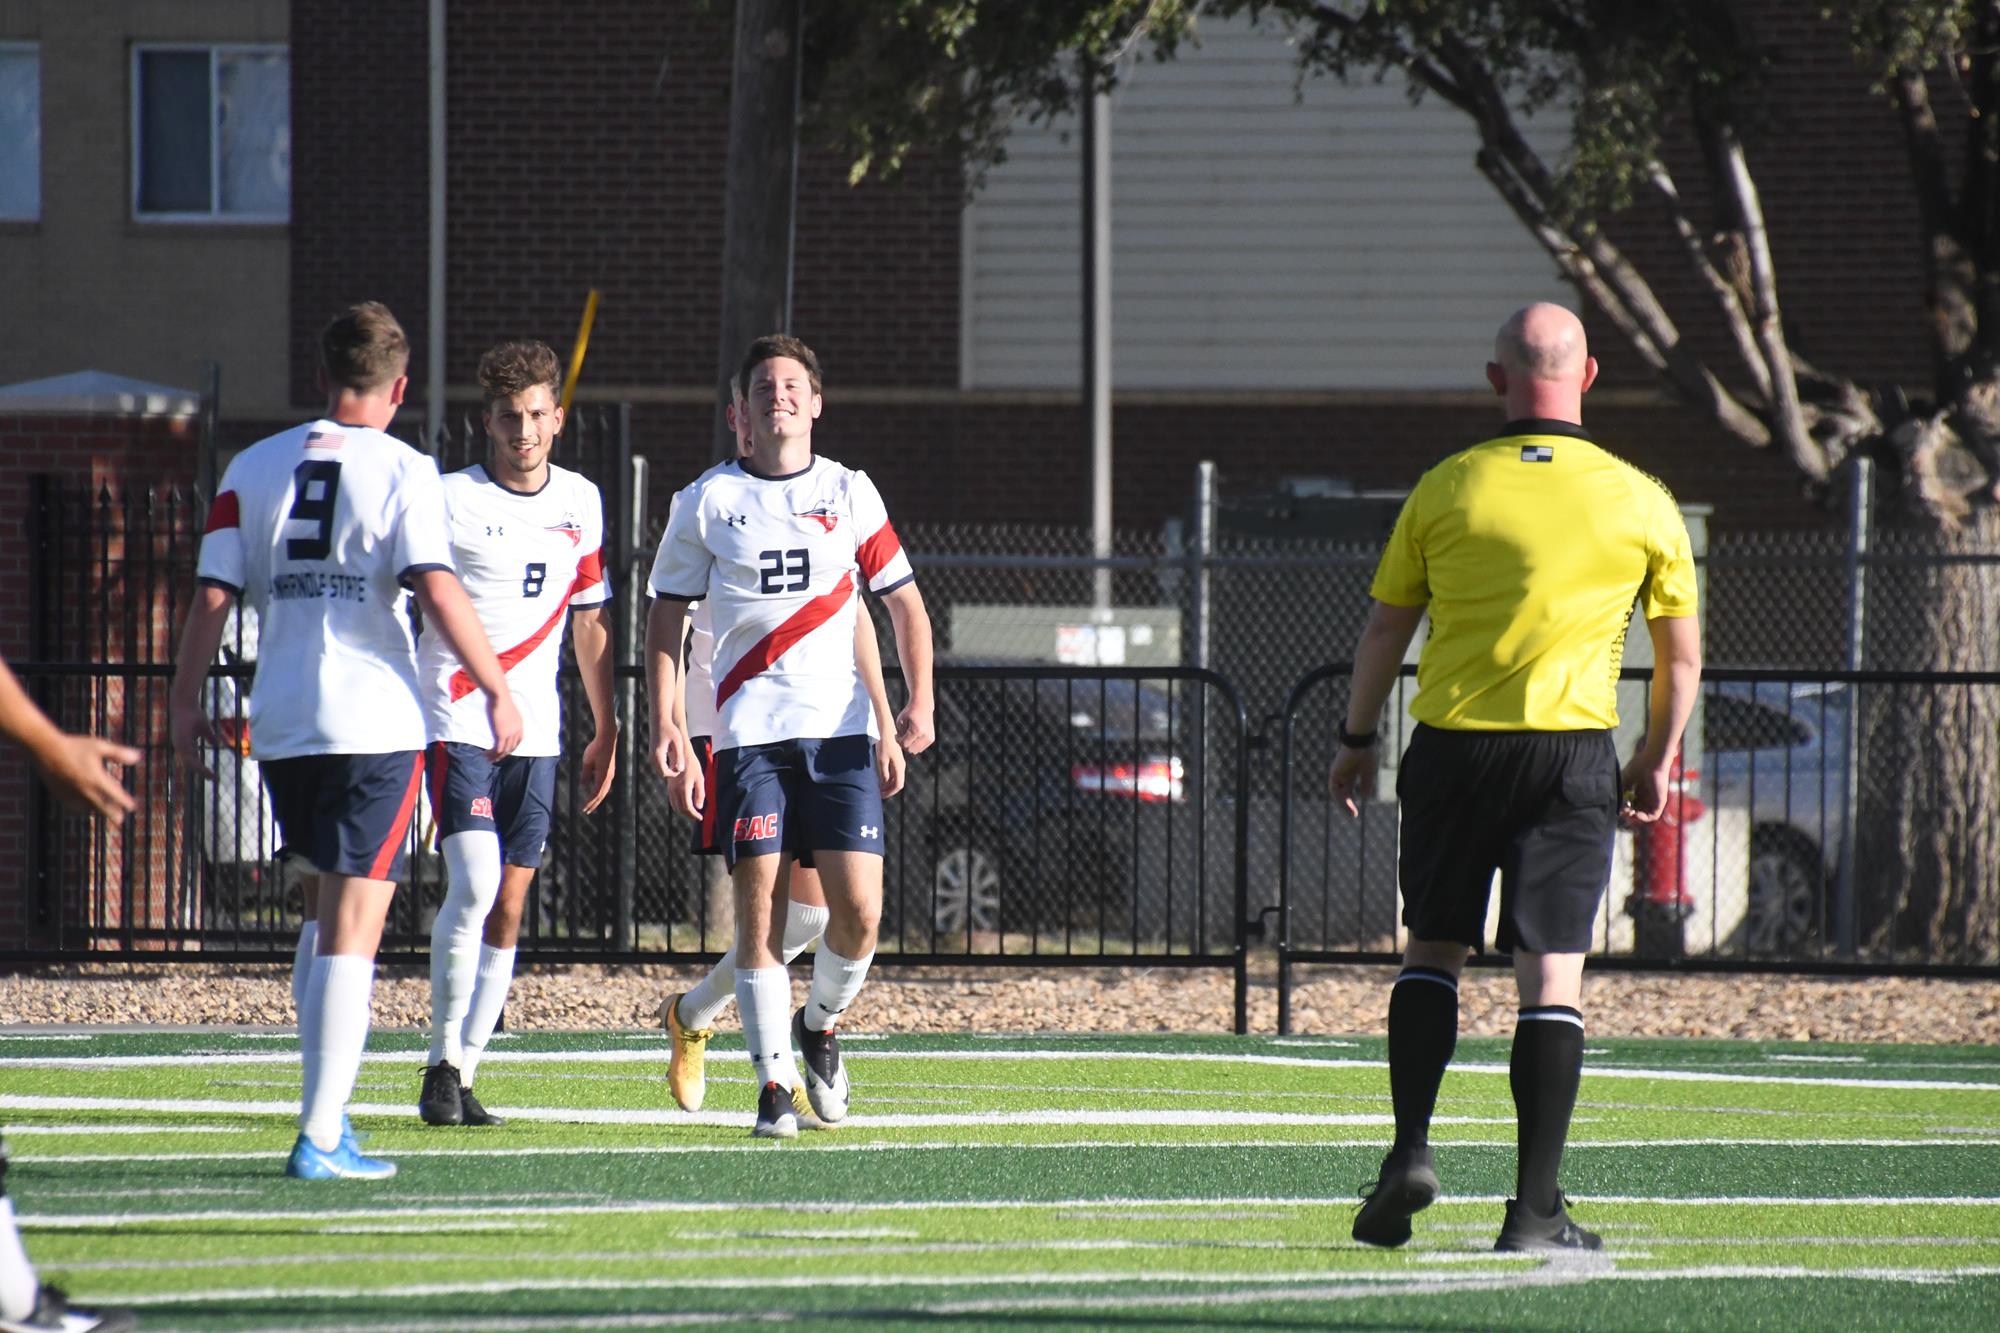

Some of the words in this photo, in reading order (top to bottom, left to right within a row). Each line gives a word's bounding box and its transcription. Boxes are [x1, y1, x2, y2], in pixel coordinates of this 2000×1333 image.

[286, 459, 342, 561] 9
[330, 574, 365, 602] STATE
[523, 562, 546, 598] 8
[759, 548, 810, 594] 23
[733, 813, 778, 841] SAC
